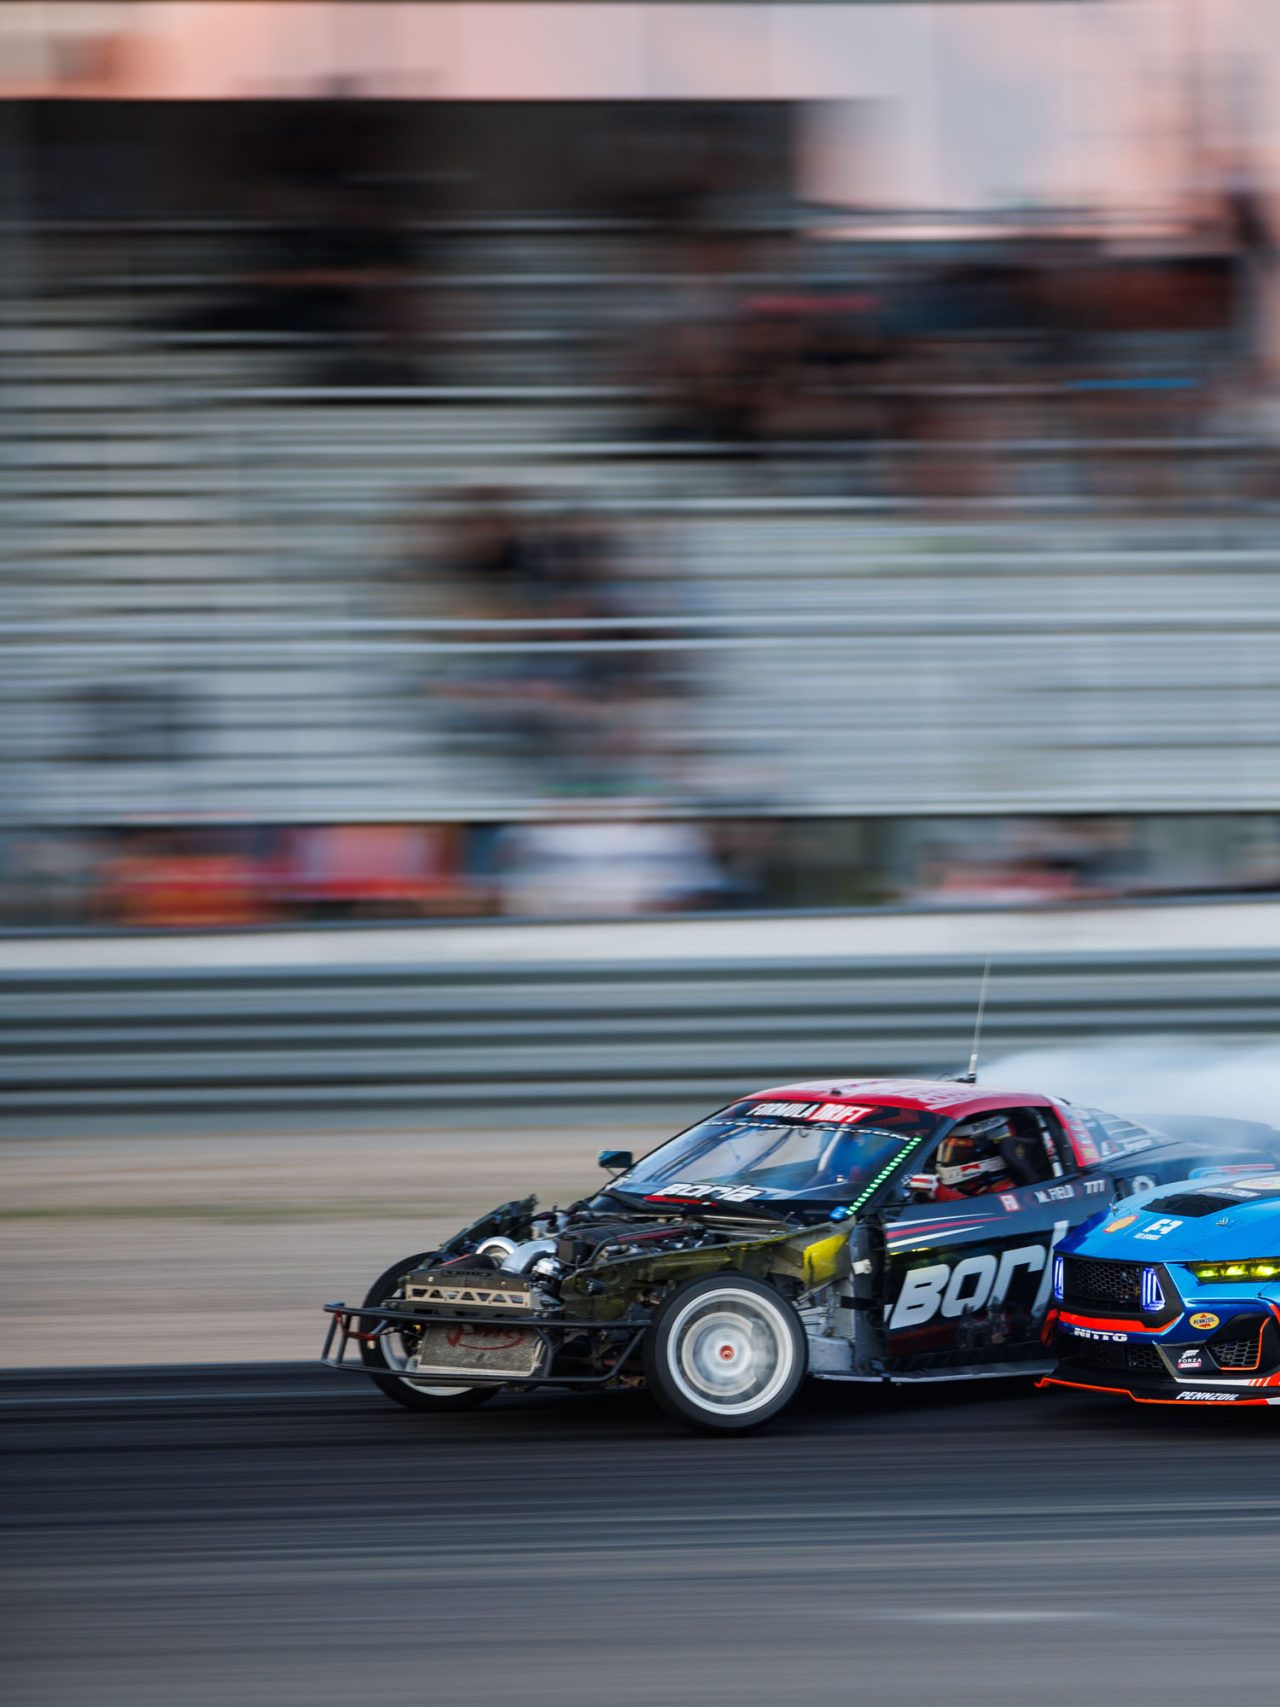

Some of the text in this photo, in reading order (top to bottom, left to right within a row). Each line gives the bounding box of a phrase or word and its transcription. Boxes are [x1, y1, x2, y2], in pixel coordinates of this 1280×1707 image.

[746, 1103, 873, 1123] FORMULA DRIFT
[1193, 1316, 1215, 1326] PENNZOIL
[1073, 1327, 1129, 1343] NITTO
[1176, 1390, 1240, 1401] PENNZOIL
